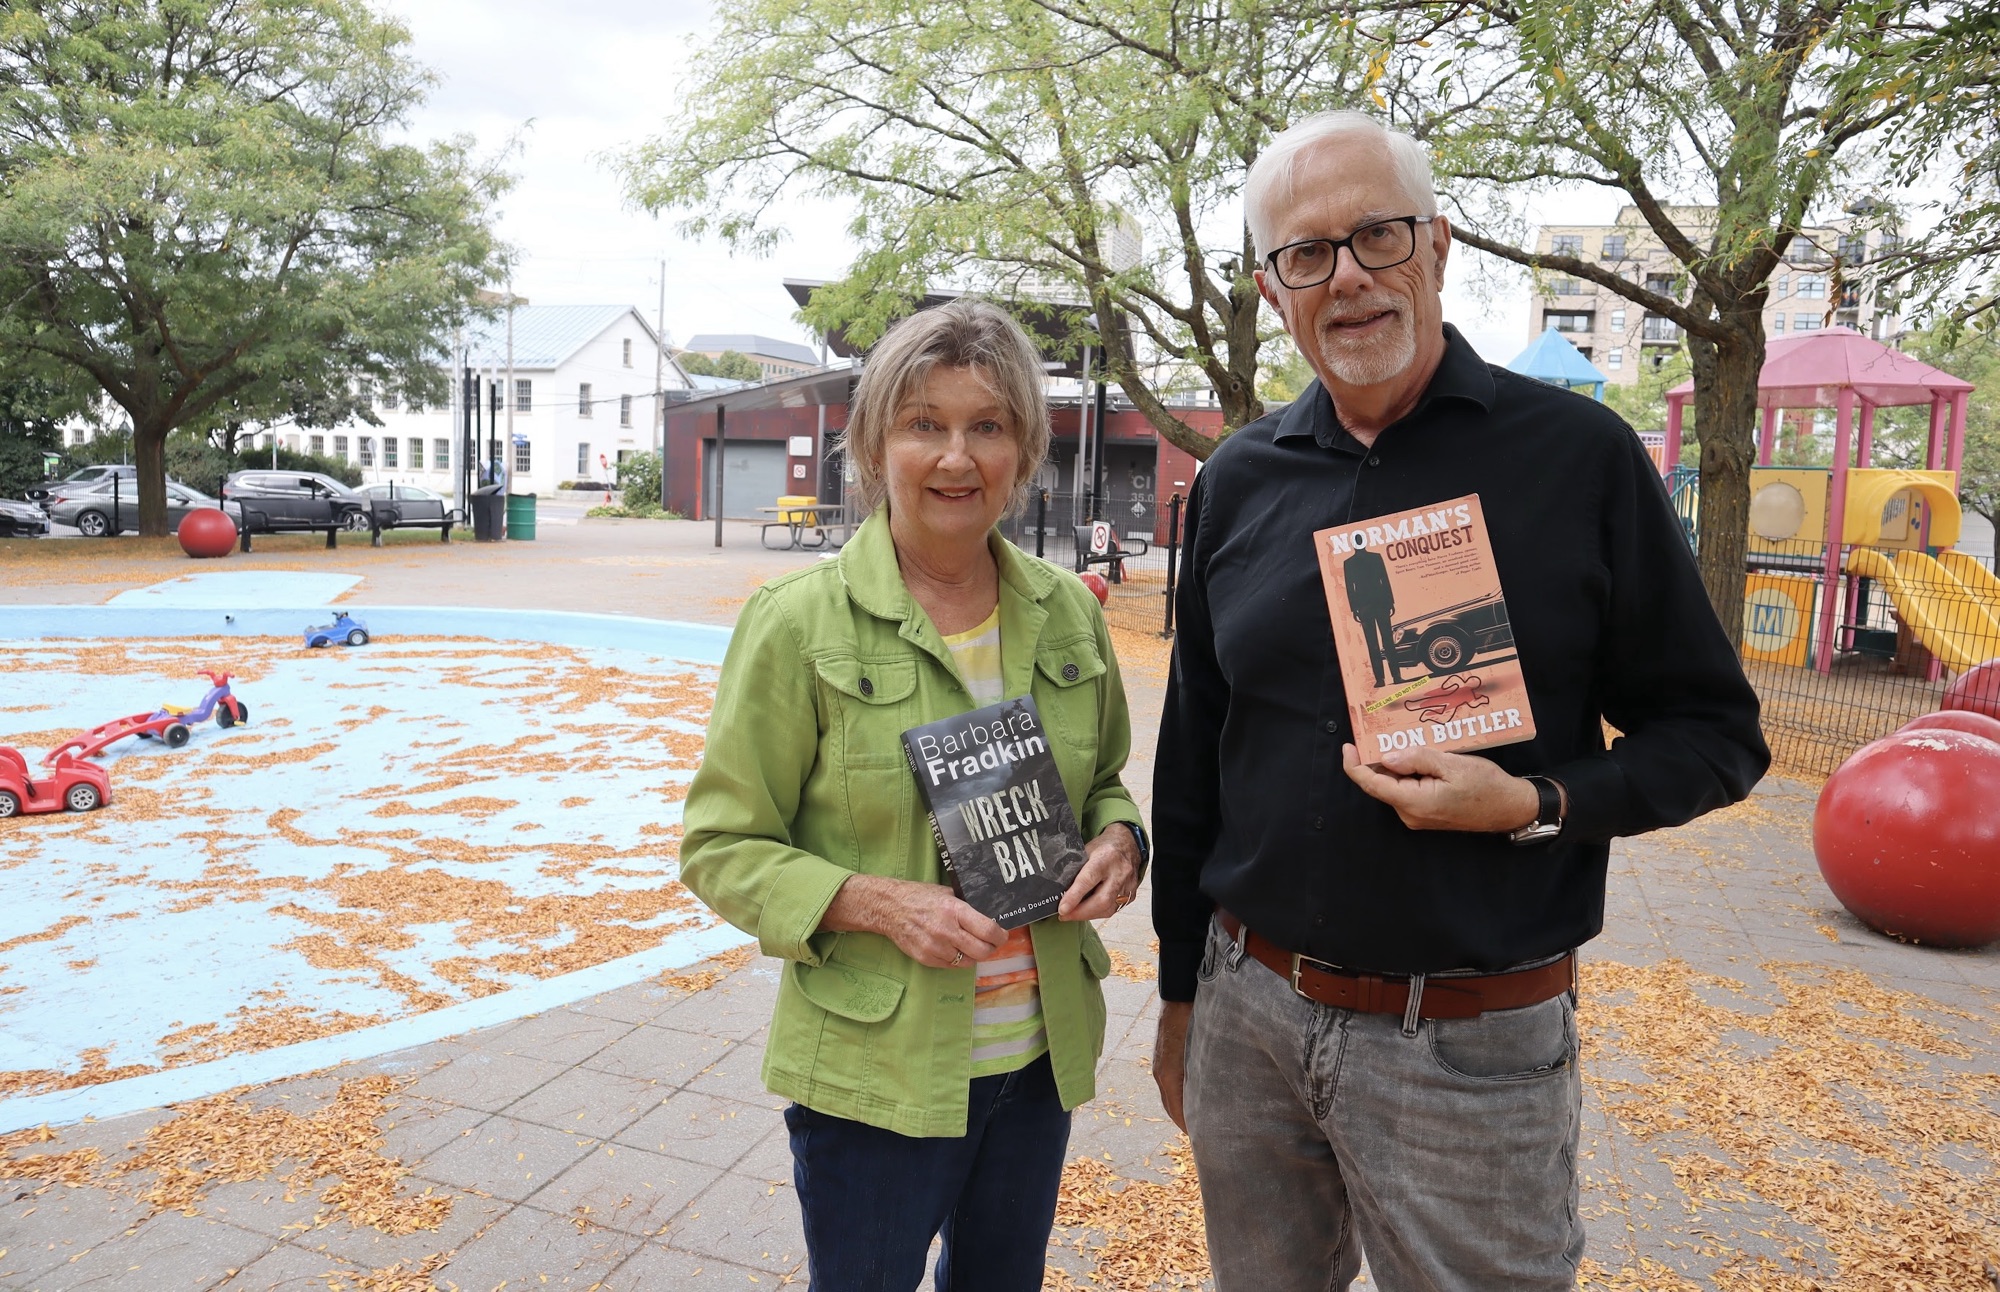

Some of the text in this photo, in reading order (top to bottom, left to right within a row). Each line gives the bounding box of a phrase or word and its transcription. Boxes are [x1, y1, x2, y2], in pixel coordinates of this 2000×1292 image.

[1329, 504, 1472, 555] NORMAN'S
[1386, 525, 1473, 562] CONQUEST
[918, 712, 1036, 761] Barbara
[1377, 708, 1522, 752] DON BUTLER
[926, 736, 1045, 786] Fradkin
[958, 779, 1049, 843] WRECK
[927, 810, 954, 872] WRECK BAY
[992, 829, 1046, 884] BAY
[999, 907, 1026, 921] Amanda
[1028, 895, 1059, 910] Doucette
